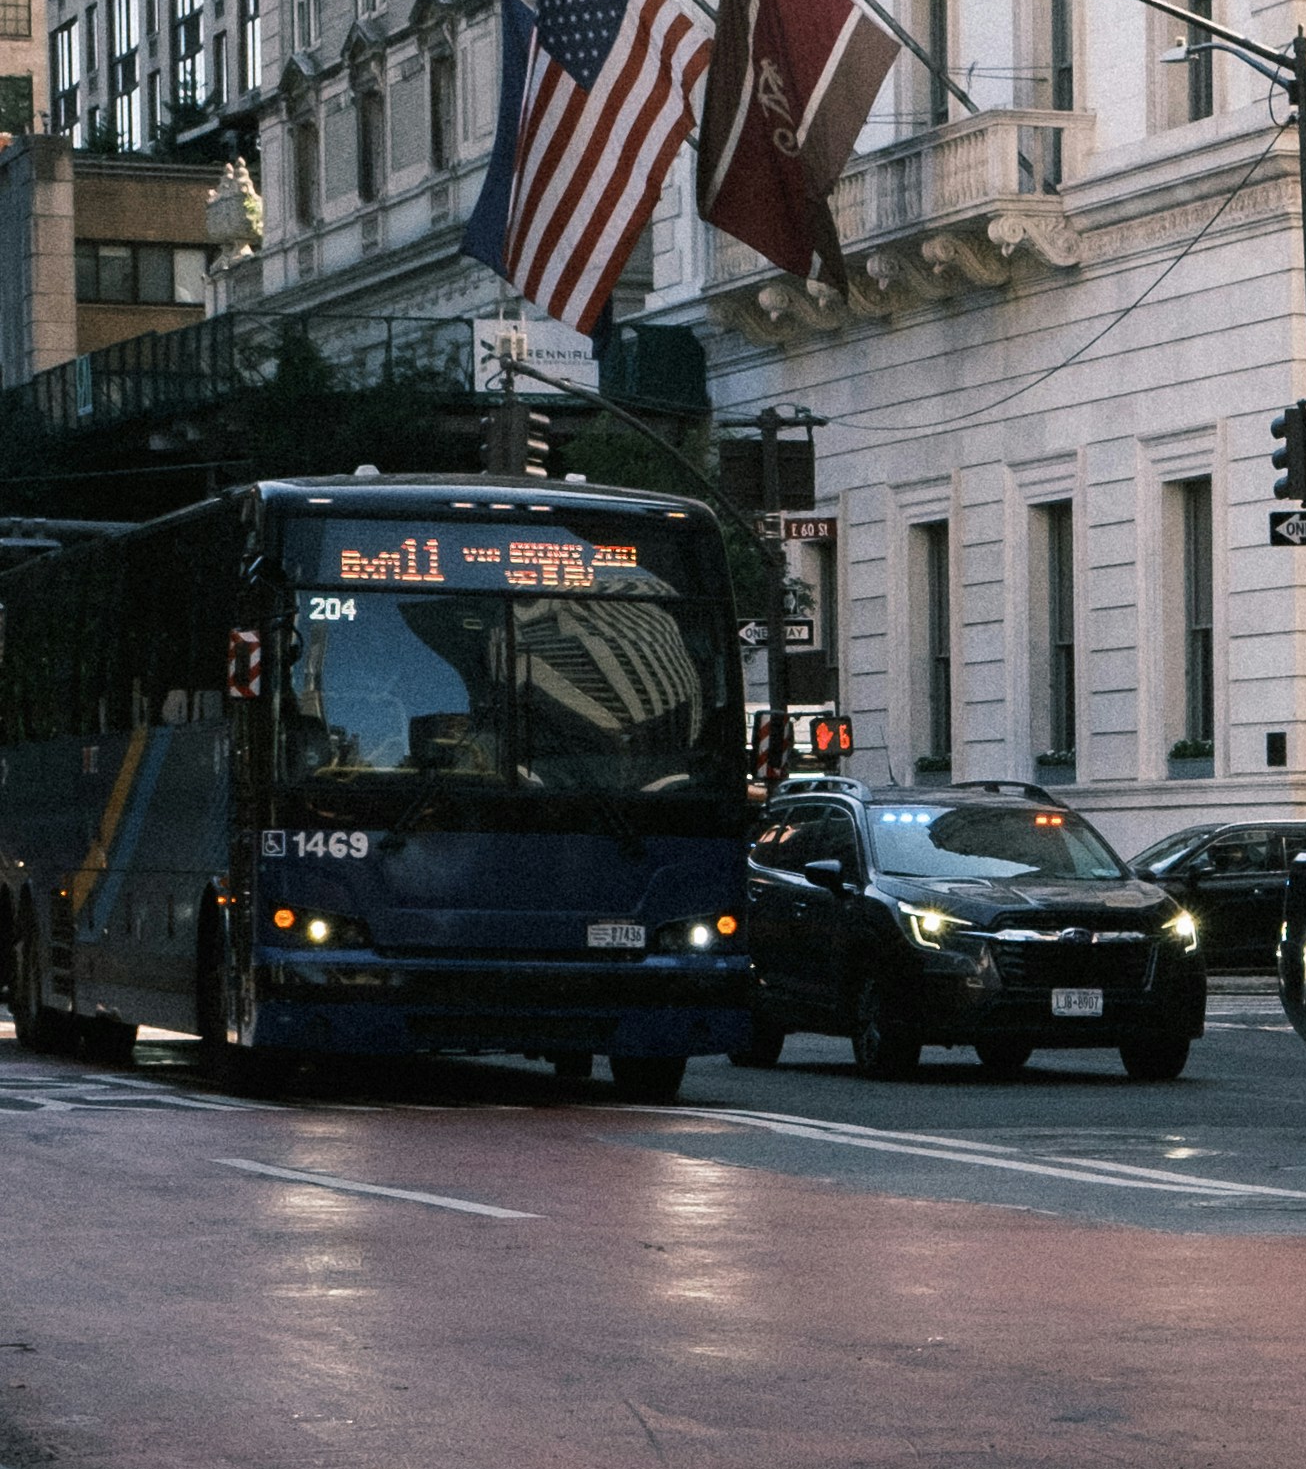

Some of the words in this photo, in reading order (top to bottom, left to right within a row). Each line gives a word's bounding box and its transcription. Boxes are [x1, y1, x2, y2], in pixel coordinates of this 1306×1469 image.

[791, 523, 799, 537] E
[801, 523, 815, 537] 60
[818, 523, 829, 537] St
[309, 597, 358, 621] 204
[745, 627, 768, 639] ONE
[786, 627, 804, 638] AY
[292, 831, 369, 859] 1469
